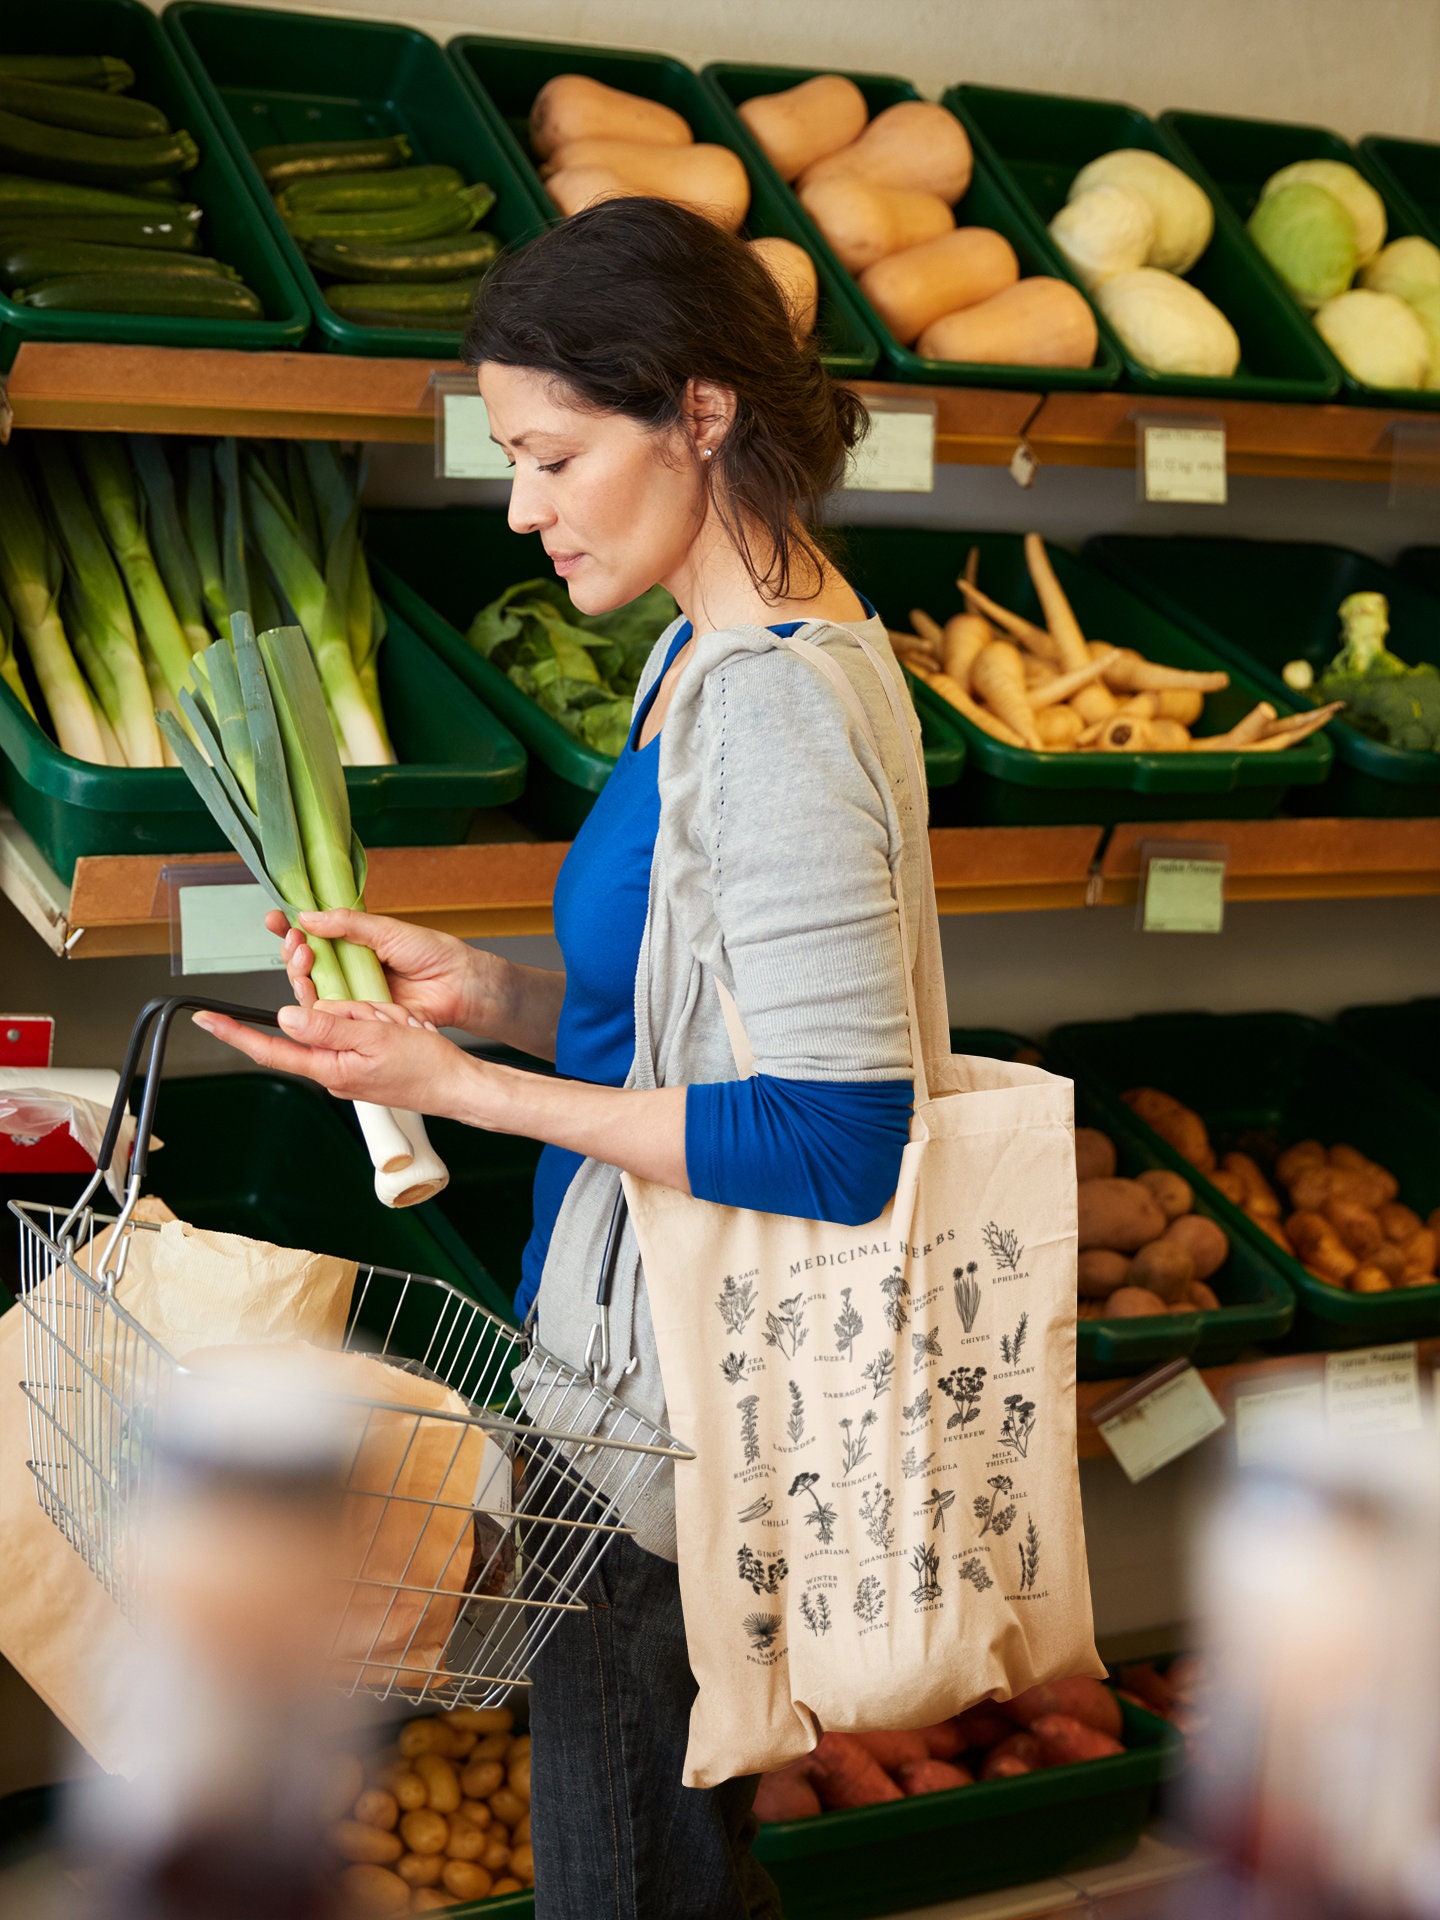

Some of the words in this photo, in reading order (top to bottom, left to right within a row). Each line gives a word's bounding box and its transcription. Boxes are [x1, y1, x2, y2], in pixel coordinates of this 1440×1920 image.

[790, 1242, 891, 1278] MEDICINAL
[900, 1230, 955, 1258] HERBS
[738, 1268, 760, 1280] SAGE
[992, 1272, 1030, 1284] EPHEDRA
[802, 1294, 826, 1306] ANISE
[906, 1286, 944, 1306] GINSENG
[914, 1294, 938, 1312] ROOT
[960, 1334, 990, 1345] CHIVES
[748, 1357, 763, 1365] TEA
[746, 1364, 766, 1373] TREE
[992, 1366, 1035, 1380] ROSEMARY
[823, 1385, 867, 1398] TARRAGON
[900, 1418, 934, 1436] PARSLEY
[943, 1430, 985, 1442] FEVERFEW
[773, 1436, 816, 1453] LAVENDER
[992, 1450, 1012, 1459] MILK
[986, 1457, 1019, 1468] THISTLE
[733, 1464, 777, 1479] RHODIOLA
[921, 1463, 958, 1478] ARUGULA
[742, 1472, 769, 1483] ROSEA
[831, 1472, 878, 1488] ECHINACEA
[913, 1508, 934, 1517] MINT
[762, 1519, 789, 1527] CHILLI
[757, 1550, 783, 1558] GINKO
[804, 1548, 849, 1560] VALERIANA
[859, 1549, 908, 1567] CHAMOMILE
[952, 1546, 991, 1560] OREGANO
[806, 1575, 838, 1585] WINTER
[807, 1583, 838, 1591] SAVORY
[1004, 1590, 1049, 1600] HORSETAIL
[914, 1603, 944, 1613] GINGER
[857, 1622, 889, 1636] TUTSAN
[746, 1648, 789, 1666] PALMETTO
[759, 1650, 776, 1658] SAW
